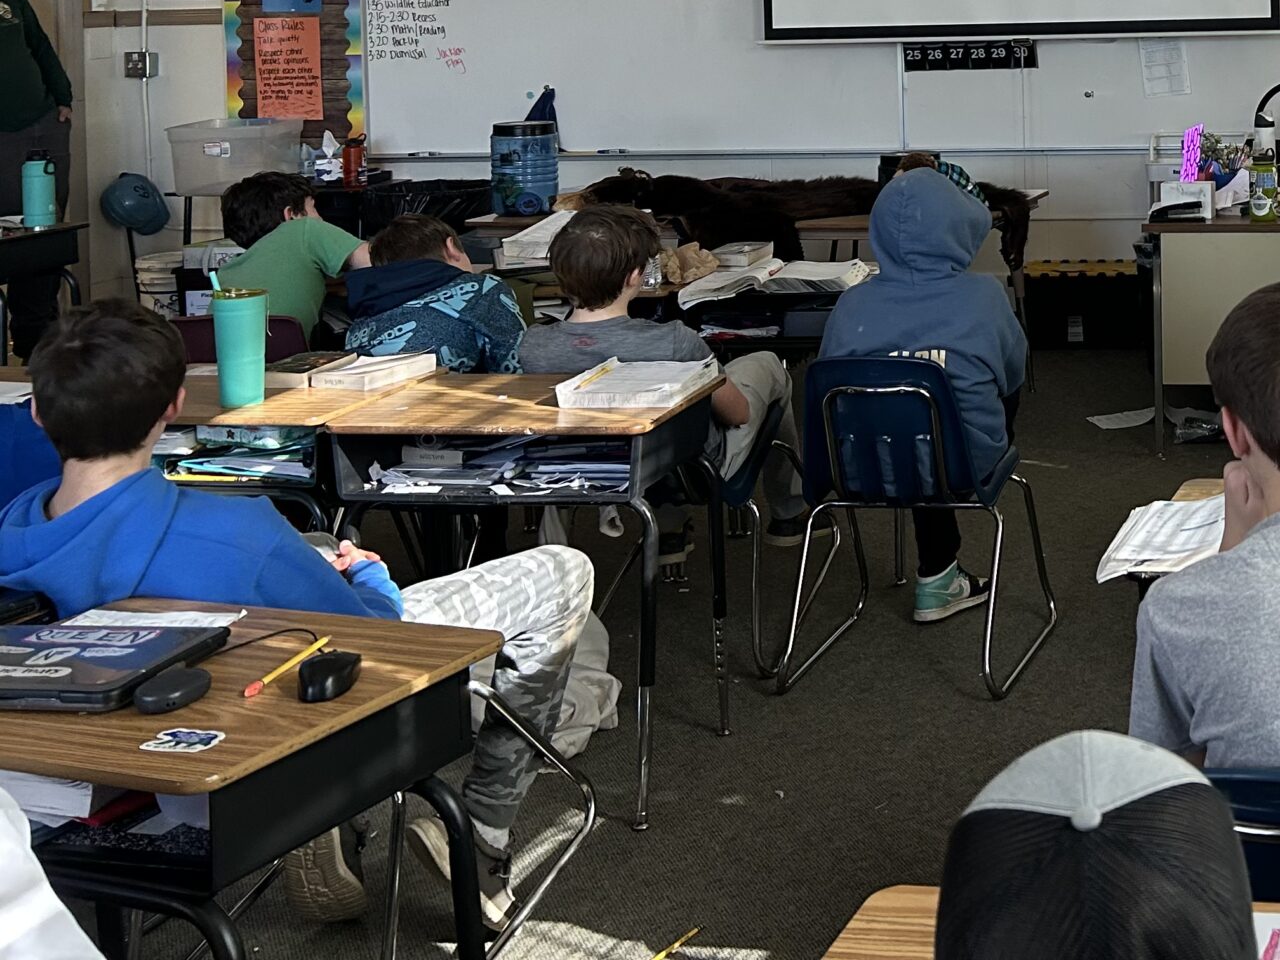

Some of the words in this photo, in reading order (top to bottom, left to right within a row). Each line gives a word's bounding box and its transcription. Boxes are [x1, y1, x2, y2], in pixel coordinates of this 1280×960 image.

[385, 0, 415, 9] Wildlife
[412, 13, 436, 22] Recess
[259, 20, 279, 33] Class
[282, 20, 305, 31] Rules
[257, 37, 273, 45] Talk
[390, 48, 427, 59] Dismissal
[906, 50, 921, 60] 25
[927, 50, 942, 59] 26
[950, 49, 964, 58] 27
[970, 49, 986, 58] 28
[991, 48, 1006, 57] 29
[1013, 48, 1028, 57] 30
[35, 630, 152, 644] QUEEN
